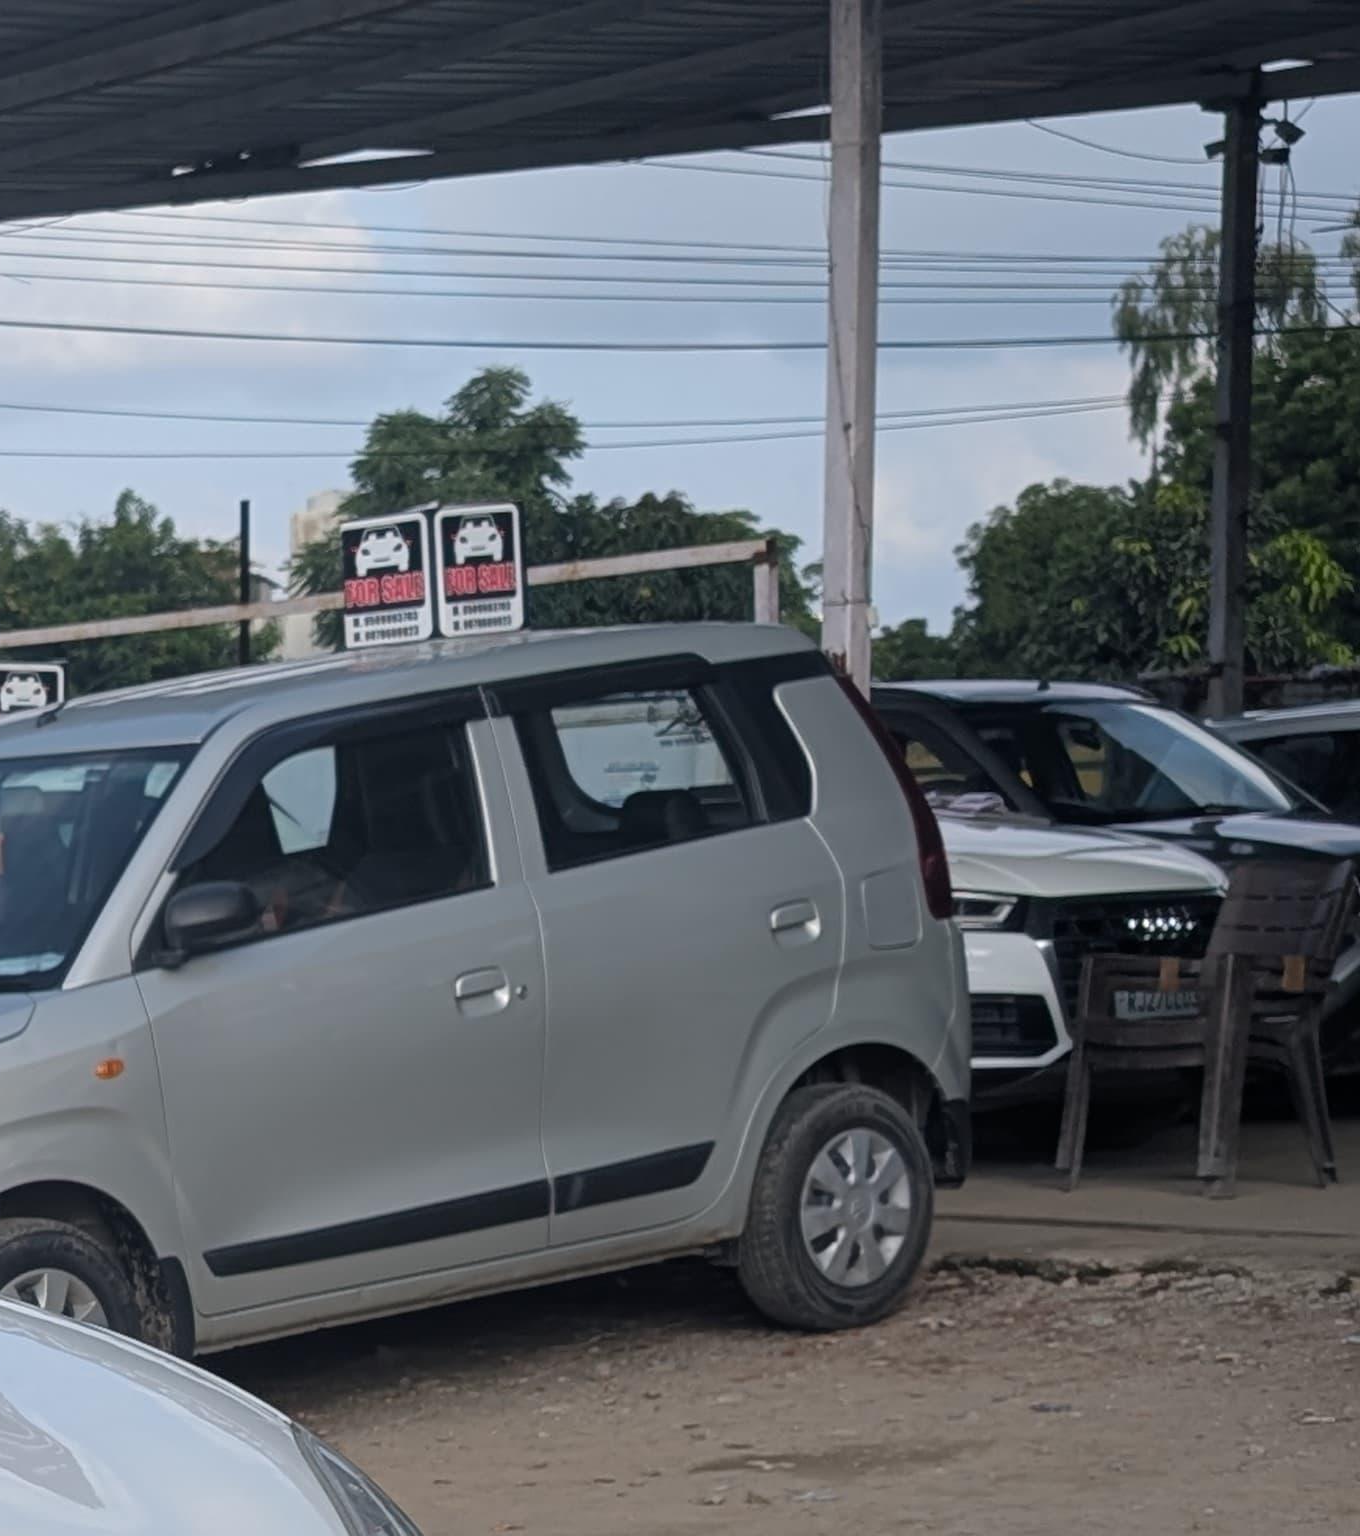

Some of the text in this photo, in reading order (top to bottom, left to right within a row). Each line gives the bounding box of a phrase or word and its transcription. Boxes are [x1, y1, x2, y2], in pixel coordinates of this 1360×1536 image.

[344, 570, 425, 609] FOR SALE
[446, 562, 517, 595] FOR SALE
